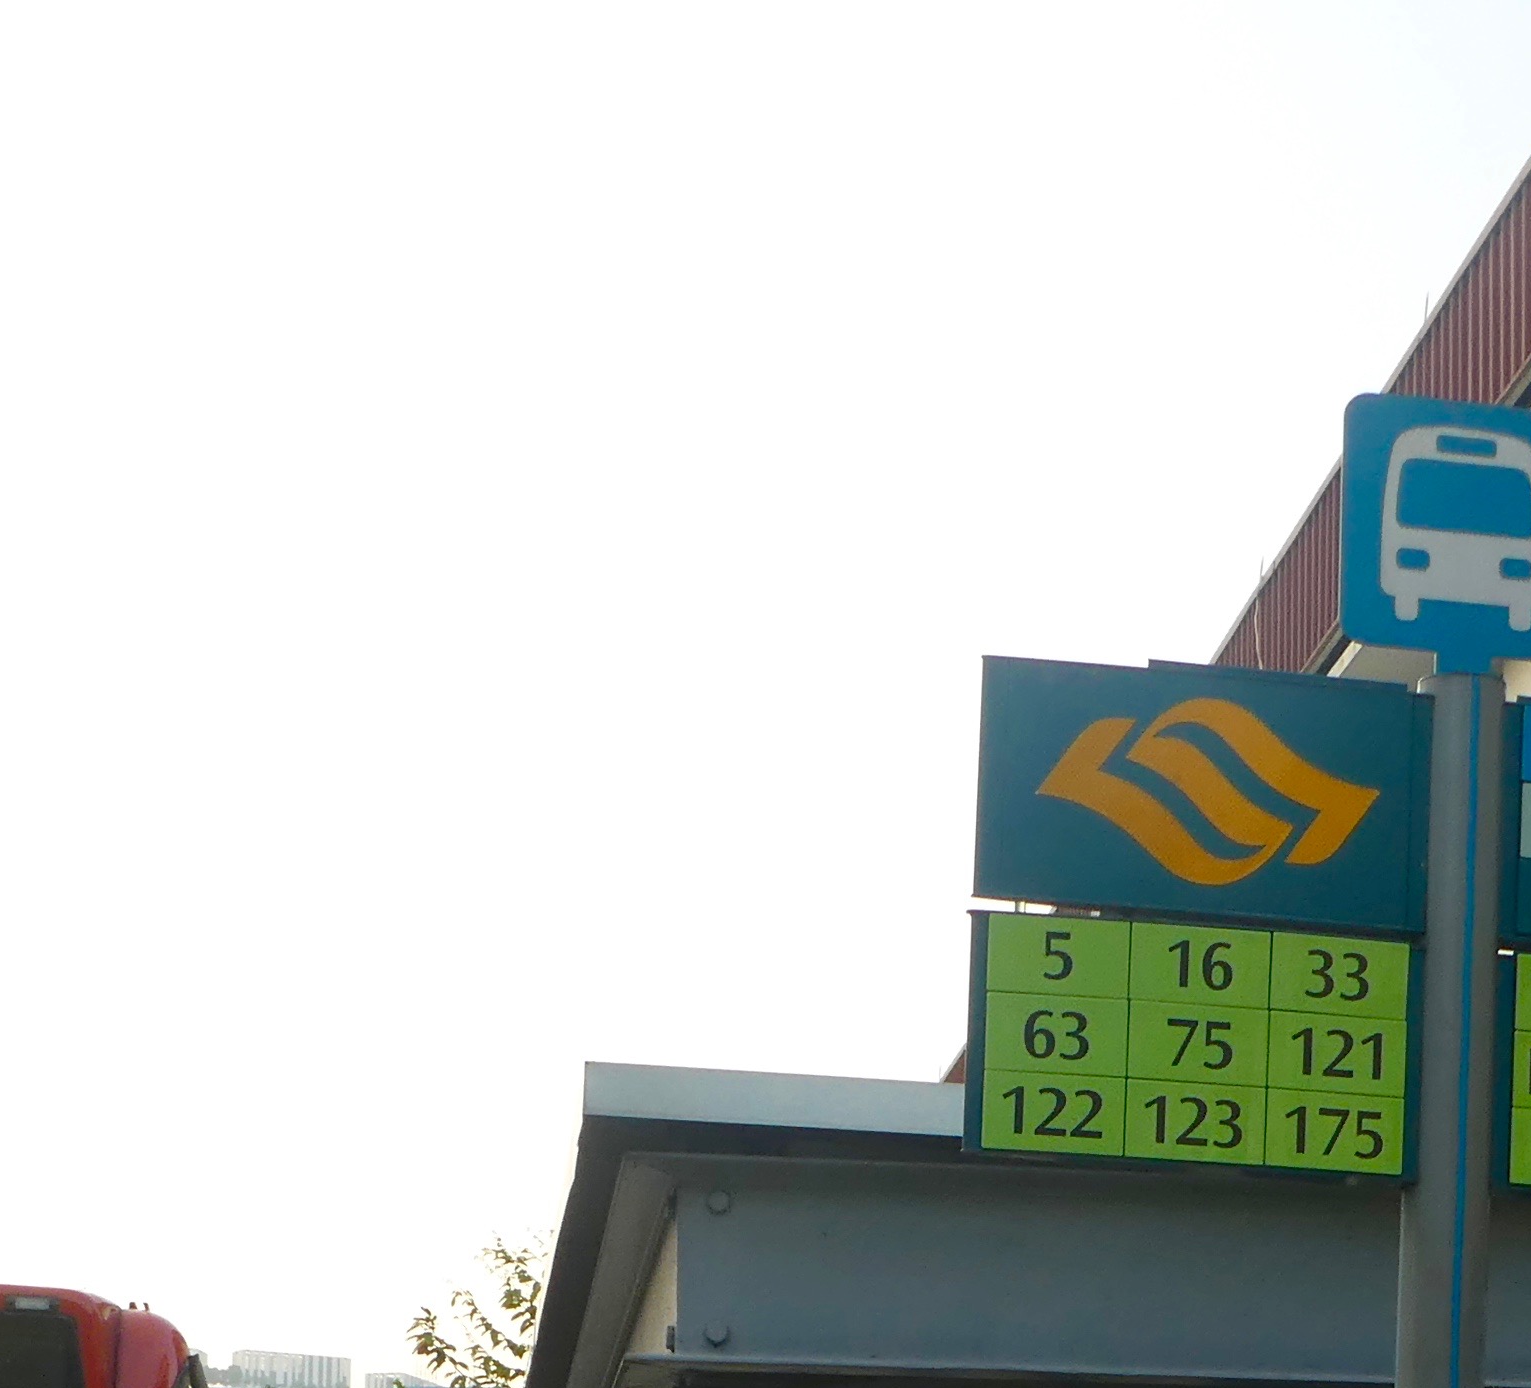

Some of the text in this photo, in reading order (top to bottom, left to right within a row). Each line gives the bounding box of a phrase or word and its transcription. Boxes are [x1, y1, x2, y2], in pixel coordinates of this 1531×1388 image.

[1042, 931, 1369, 1001] 5 16 33
[1024, 1010, 1383, 1080] 63 75 121
[1002, 1086, 1383, 1160] 122 123 175
